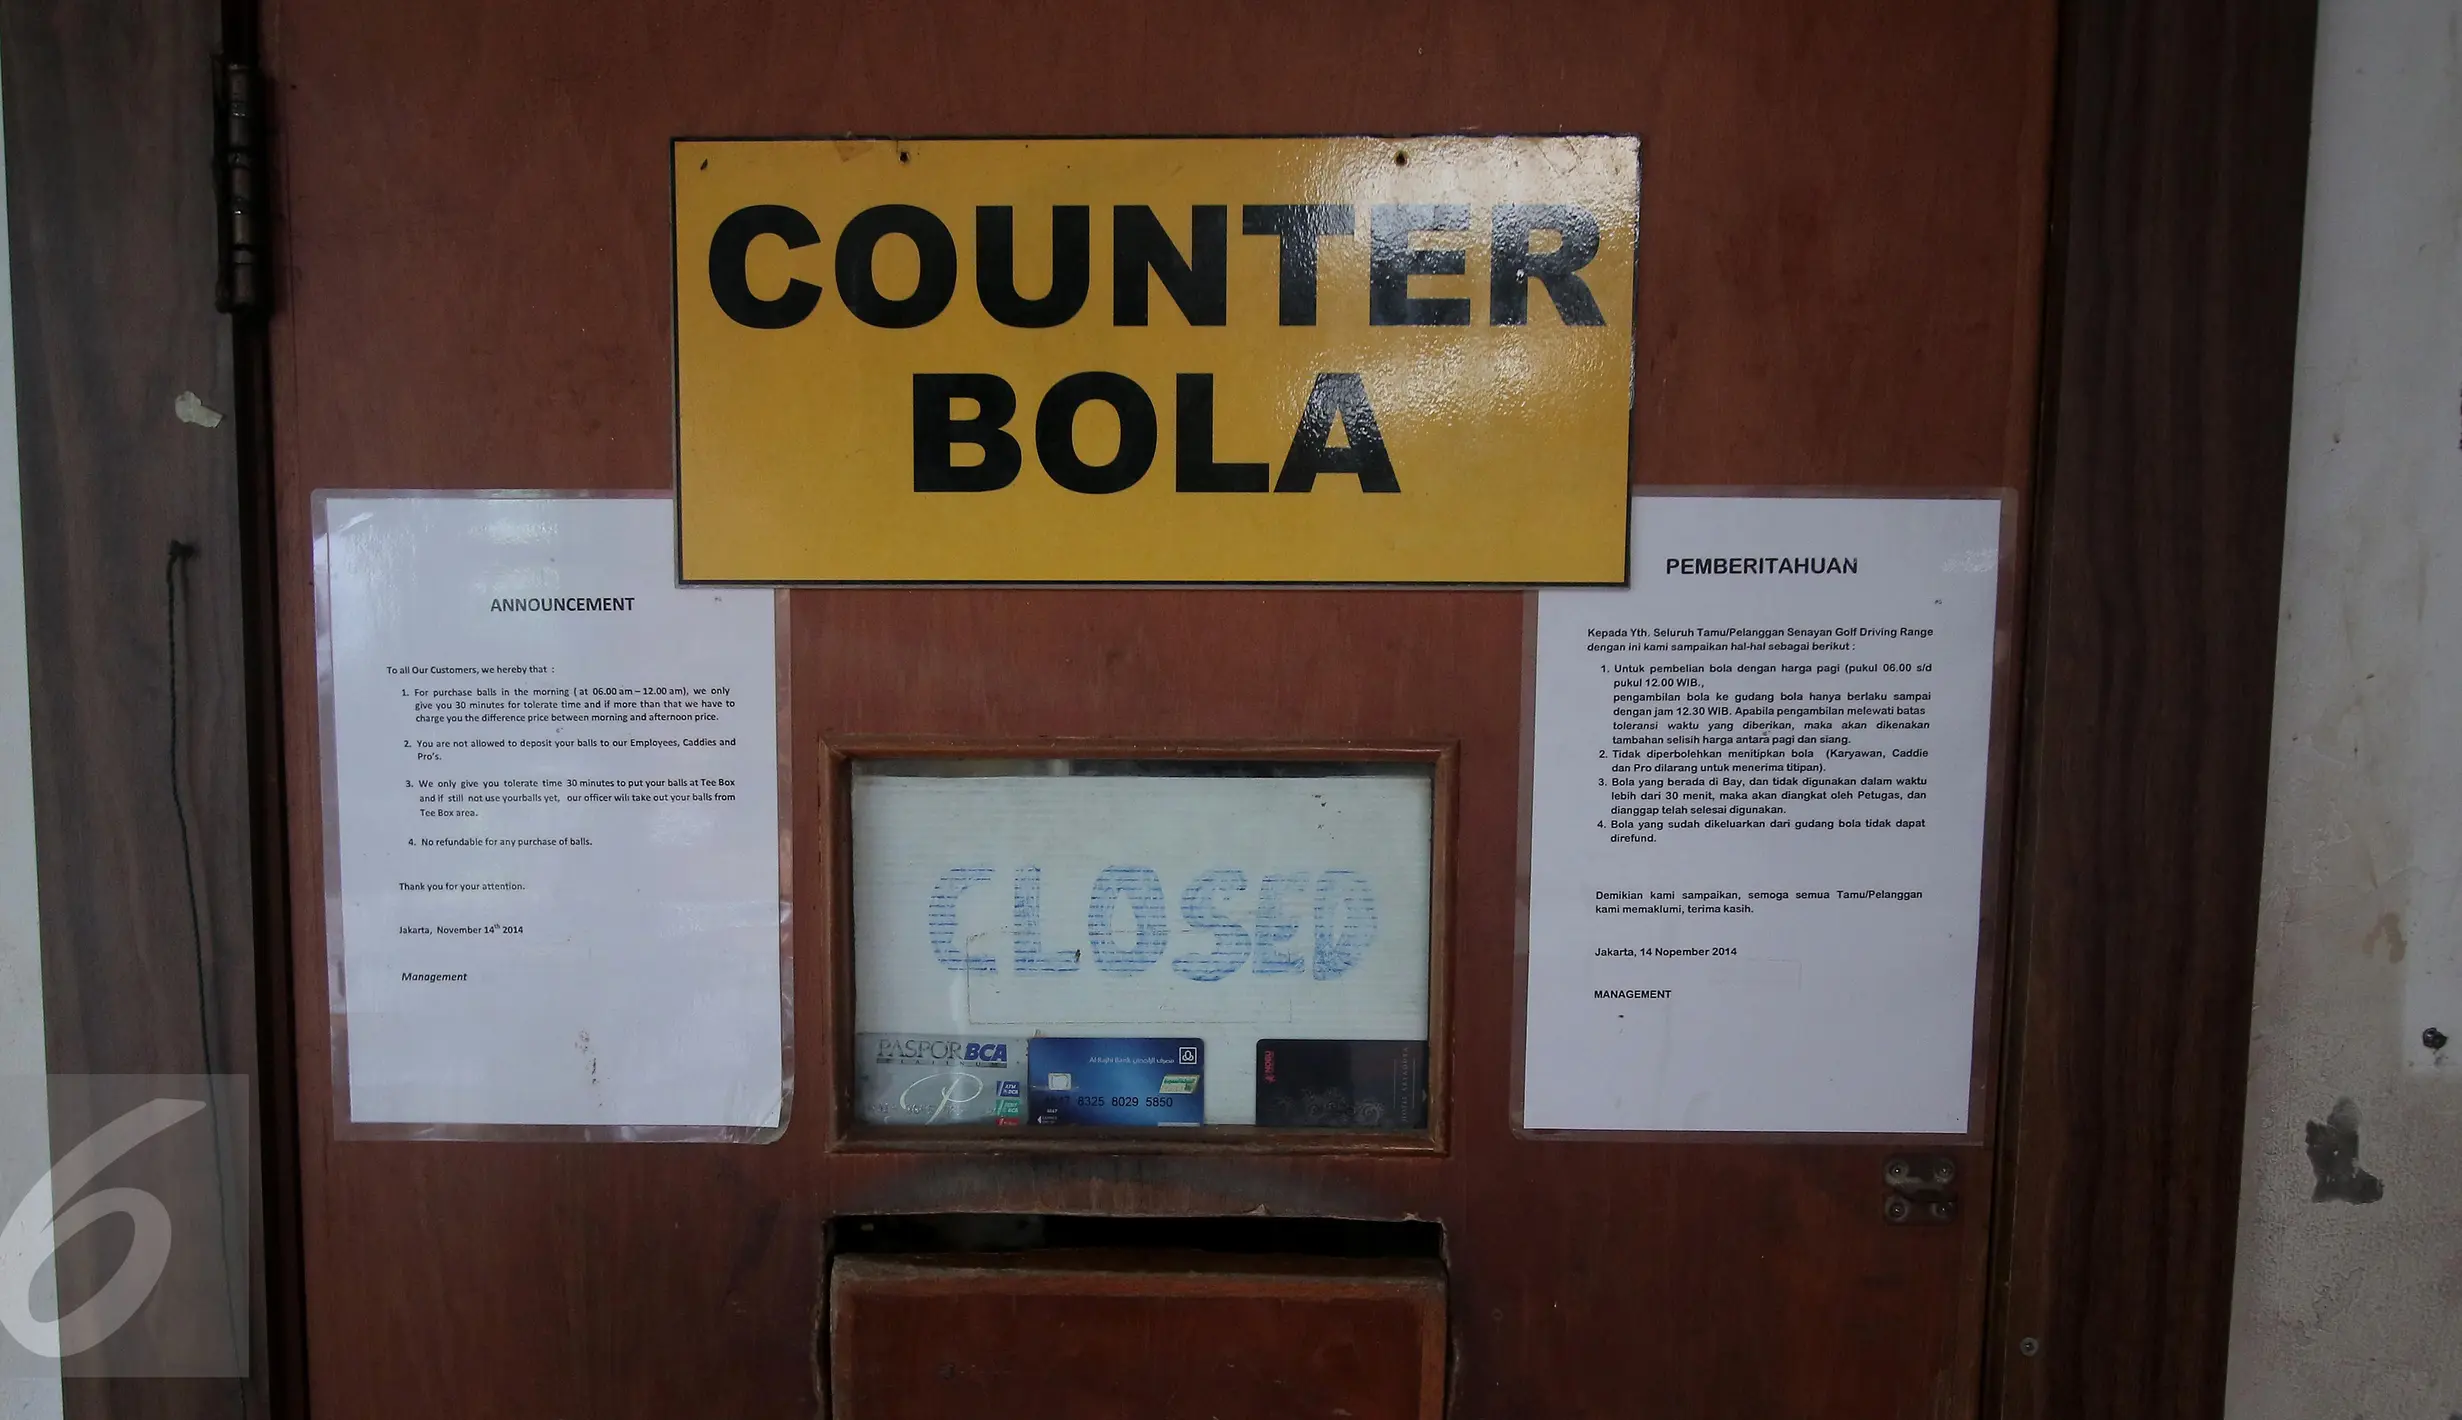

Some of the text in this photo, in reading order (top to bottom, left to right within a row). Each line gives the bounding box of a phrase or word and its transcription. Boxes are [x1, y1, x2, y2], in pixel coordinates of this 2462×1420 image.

[708, 204, 1607, 329] COUNTER
[912, 370, 1401, 493] BOLA
[1666, 558, 1857, 574] PEMBERITAHUAN
[490, 597, 635, 611] ANNOUNCEMENT
[1587, 626, 1933, 639] Kepada Yth. Seluruh Tamu/Pelanggan Senayan Golf Driving Range
[1587, 642, 1626, 653] dengan
[1628, 642, 1641, 651] ini
[1643, 641, 1668, 651] kami
[1670, 641, 1728, 653] sampaikan
[1730, 641, 1766, 650] hal-hal
[1768, 641, 1809, 653] sebagai
[1811, 641, 1850, 650] berikut
[386, 665, 398, 674] To
[399, 665, 410, 674] all
[411, 664, 428, 674] Our
[430, 664, 480, 675] Customers,
[496, 664, 527, 675] hereby
[528, 664, 547, 673] that
[1600, 662, 1932, 675] 1. Untuk pembelian bola dengan harga pagi (pukul 06.00 s/d
[1613, 678, 1704, 689] pukul 12.00 WIB.,
[415, 700, 432, 711] give
[435, 702, 452, 711] you
[454, 700, 466, 709] 30
[469, 699, 504, 709] minutes
[508, 699, 521, 708] for
[522, 699, 558, 708] tolerate
[560, 699, 581, 708] time
[583, 699, 601, 708] and
[603, 698, 610, 708] if
[639, 698, 660, 707] than
[663, 698, 682, 707] that
[701, 698, 722, 707] have
[725, 698, 735, 707] to
[415, 711, 718, 724] charge you the difference price between morning and afternoon price.
[404, 738, 411, 748] 2.
[416, 738, 434, 747] You
[452, 738, 468, 747] not
[470, 738, 505, 747] allowed
[507, 738, 518, 747] to
[520, 737, 552, 749] deposit
[554, 740, 575, 749] your
[576, 737, 597, 746] balls
[599, 737, 610, 746] to
[630, 737, 680, 748] Employees,
[682, 736, 716, 746] Caddies
[719, 736, 736, 746] and
[1612, 734, 1851, 746] tambahan selisih harga antara pagi dan siang.
[1599, 748, 1928, 760] 2. Tidak diperbolehkan menitipkan bola (Karyawan, Caddie
[1611, 762, 1825, 774] dan Pro dilarang untuk menerima titipan).
[408, 836, 592, 848] 4. No refundable for any purchase of balls.
[1610, 833, 1656, 842] direfund.
[398, 881, 525, 892] Thank you for your attention.
[1595, 890, 1643, 899] Demikian
[1650, 890, 1675, 899] kami
[1681, 890, 1741, 901] sampaikan,
[1748, 891, 1788, 901] semoga
[1836, 889, 1922, 901] Tamu/Pelanggan
[1595, 903, 1753, 914] kami memaklumi, terima kasih.
[399, 924, 432, 935] Jakarta,
[436, 924, 482, 934] November
[502, 924, 523, 934] 2014
[929, 865, 1378, 983] CLOSED
[1594, 946, 1737, 958] Jakarta, 14 Nopember 2014
[401, 971, 467, 983] Management
[1594, 989, 1671, 998] MANAGEMENT
[1077, 1096, 1105, 1107] 8325
[1111, 1096, 1139, 1107] 8029
[1145, 1096, 1173, 1107] 5850
